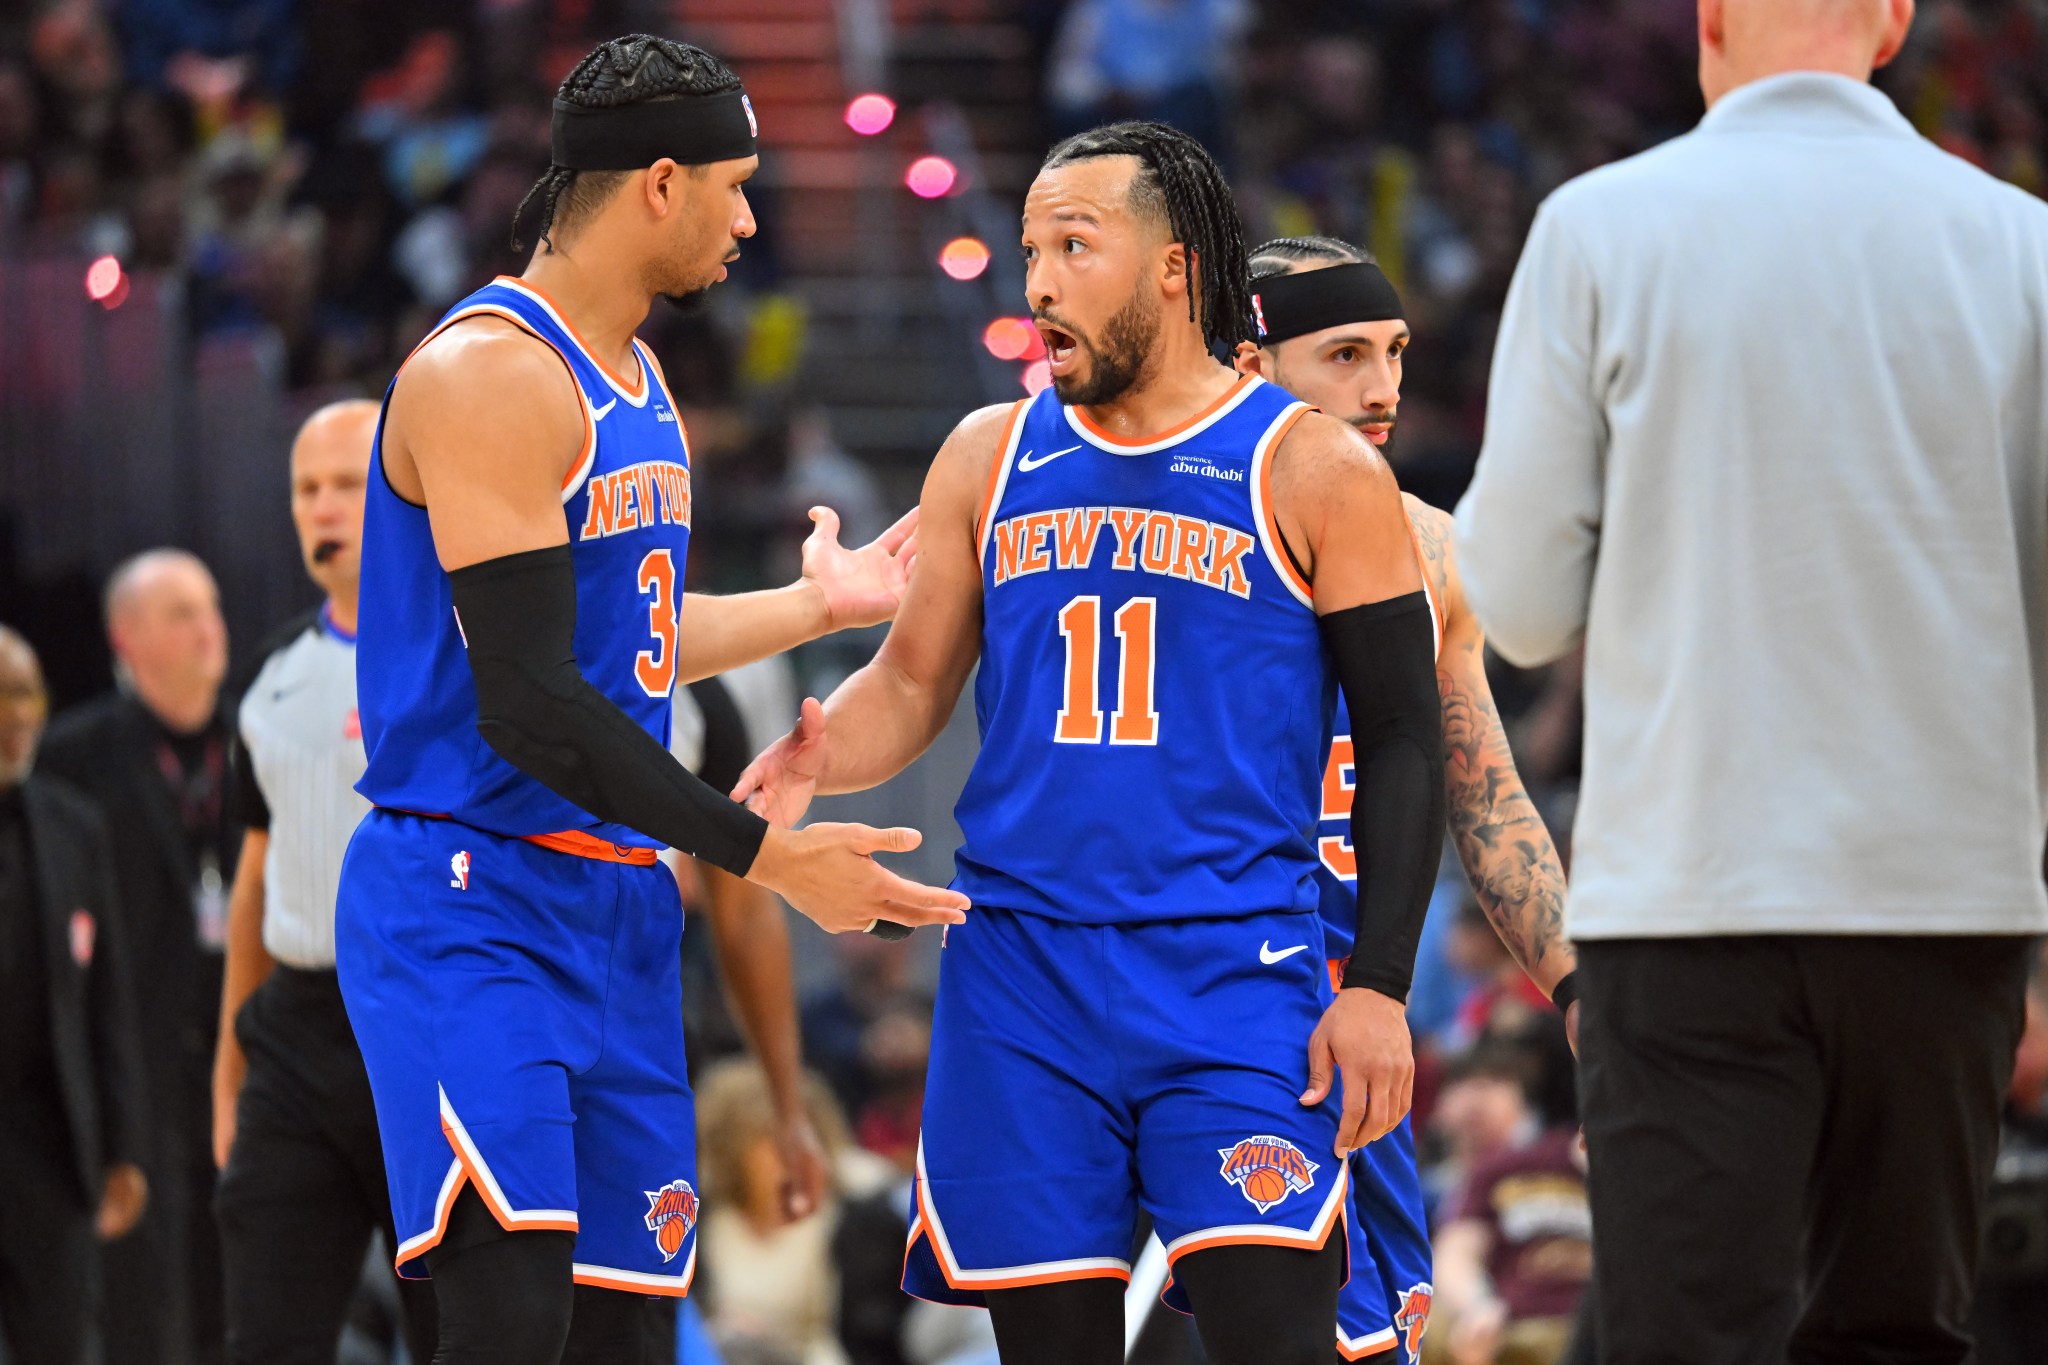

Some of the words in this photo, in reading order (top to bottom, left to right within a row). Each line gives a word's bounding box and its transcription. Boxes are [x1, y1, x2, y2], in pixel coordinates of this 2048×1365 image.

[1170, 462, 1198, 474] abu
[1200, 465, 1243, 481] dhabi
[1173, 455, 1212, 464] experience
[579, 461, 654, 541] NEW
[651, 460, 691, 533] YOR
[994, 506, 1107, 587] NEW
[1107, 506, 1255, 600] YORK
[634, 549, 678, 697] 3
[1053, 595, 1159, 745] 11
[1223, 1141, 1310, 1184] KNICKS
[1271, 1139, 1289, 1149] YORK
[648, 1188, 695, 1225] KNICKS
